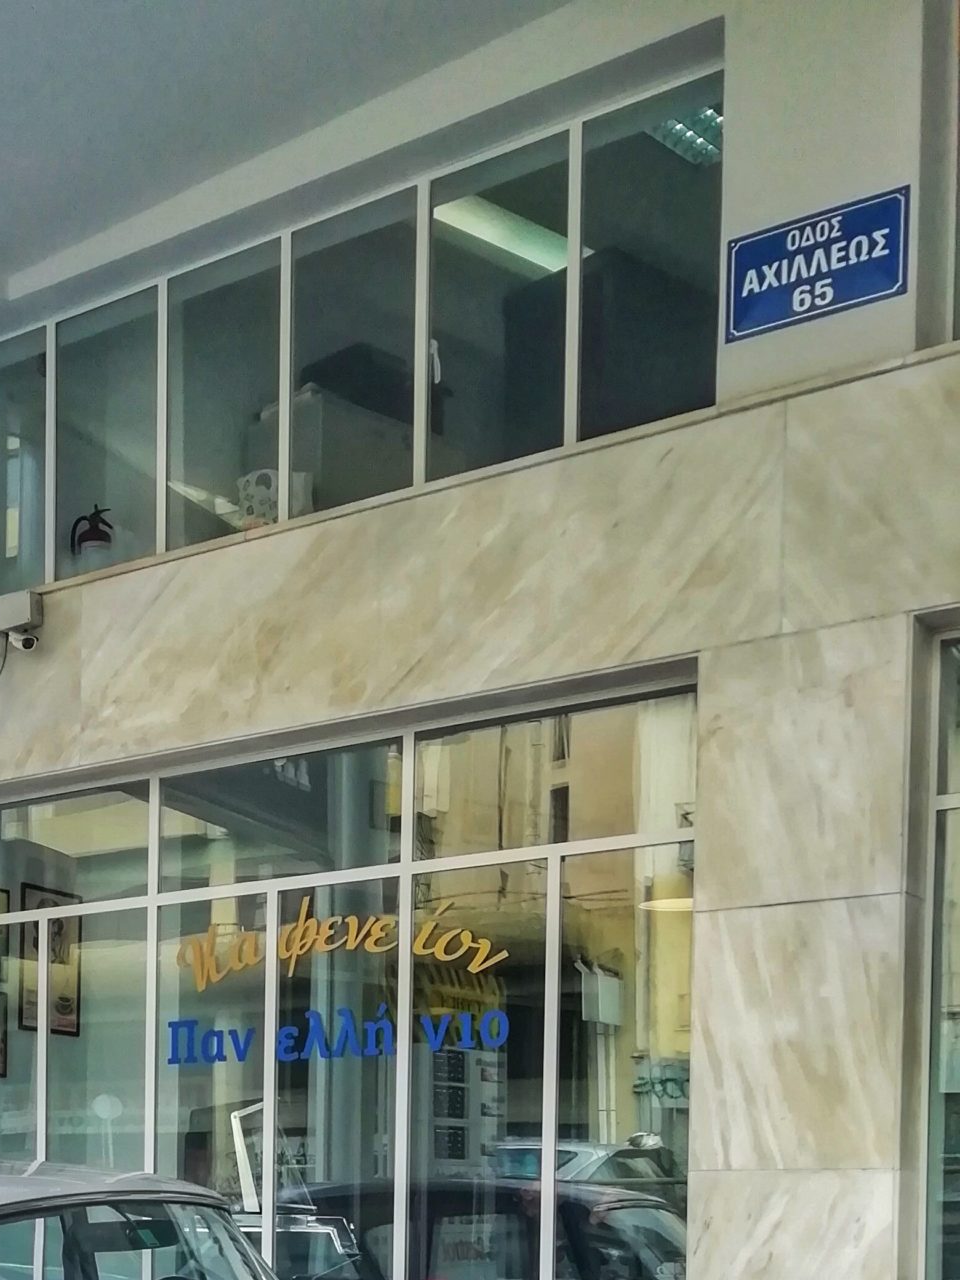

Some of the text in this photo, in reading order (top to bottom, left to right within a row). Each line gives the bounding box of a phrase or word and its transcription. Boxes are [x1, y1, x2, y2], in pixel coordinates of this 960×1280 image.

[786, 216, 843, 251] ΟΔΟΣ
[741, 228, 890, 298] ΑΧΙΛΛΕΩΣ
[792, 278, 834, 312] 65
